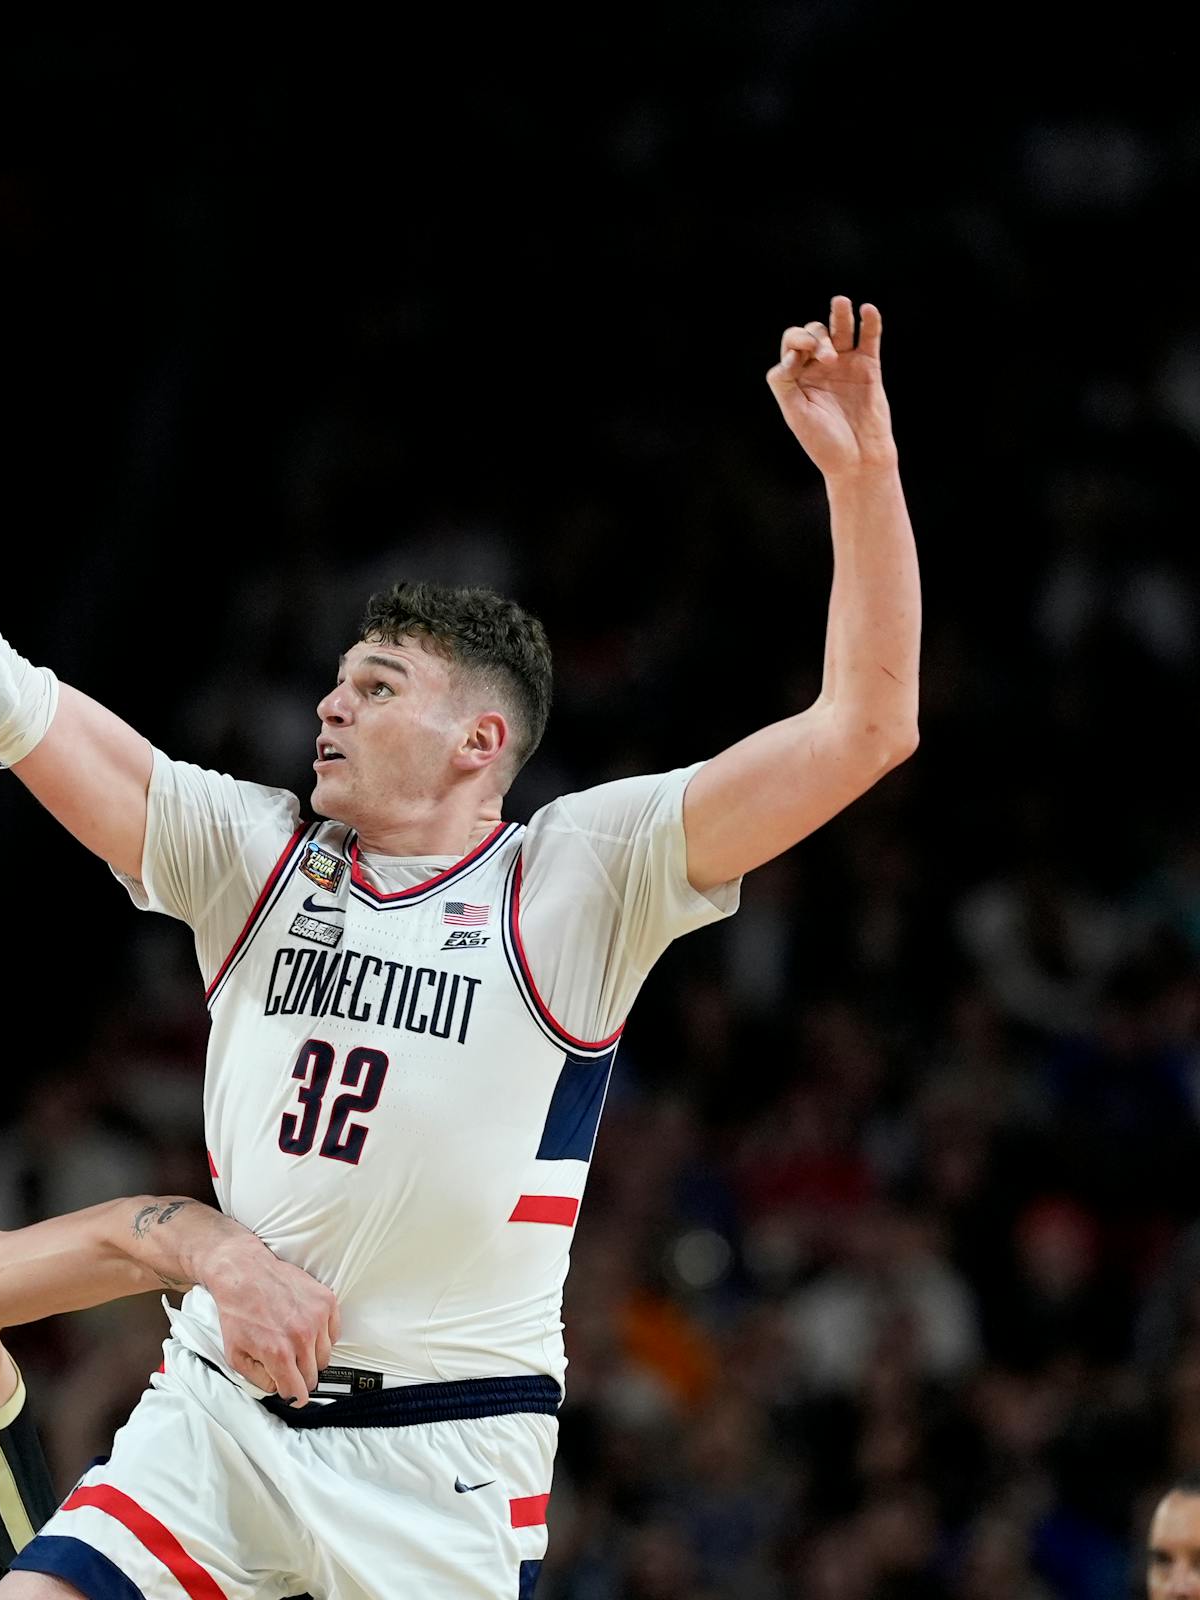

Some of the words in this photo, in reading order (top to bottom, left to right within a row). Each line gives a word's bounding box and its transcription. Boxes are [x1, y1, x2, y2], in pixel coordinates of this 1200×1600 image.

[307, 858, 335, 878] FOUR
[309, 851, 337, 870] FINAL
[291, 926, 337, 945] CHANGE
[444, 937, 491, 947] EAST
[449, 930, 482, 939] BIG
[278, 1039, 389, 1165] 32
[358, 1376, 375, 1390] 50
